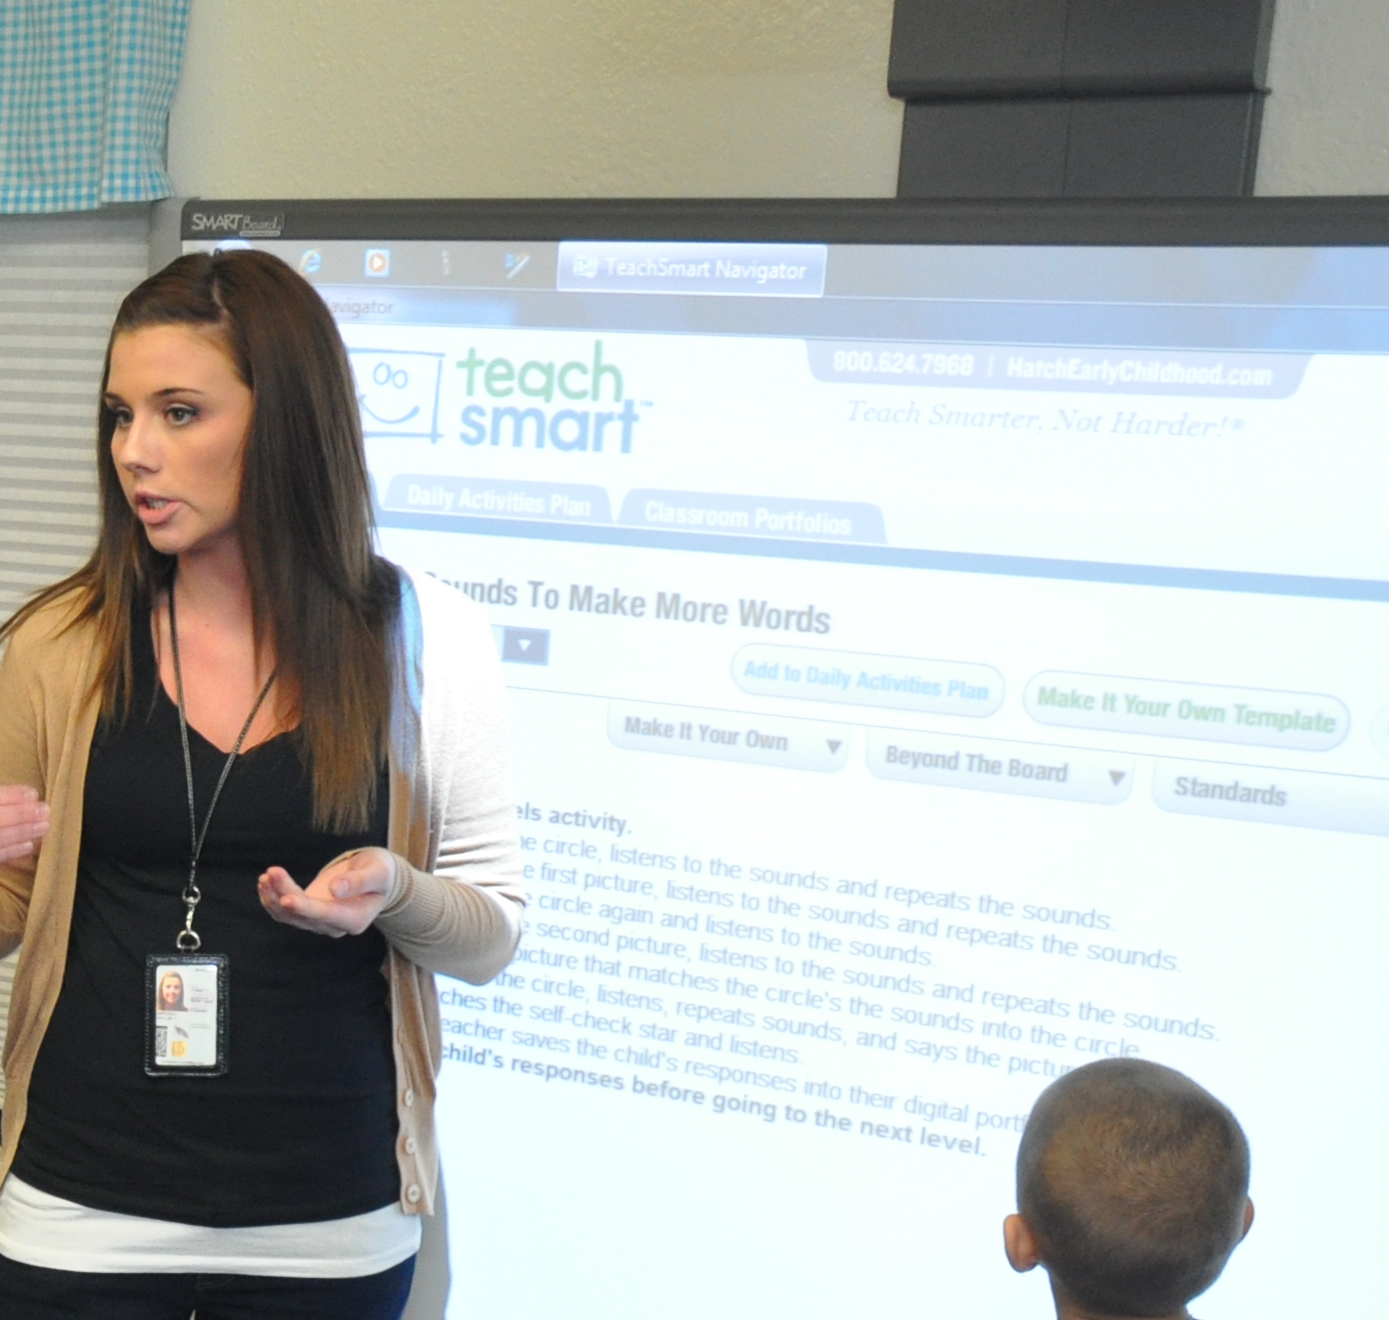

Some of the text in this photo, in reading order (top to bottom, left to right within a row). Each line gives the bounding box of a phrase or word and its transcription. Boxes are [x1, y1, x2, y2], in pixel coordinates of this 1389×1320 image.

[191, 213, 242, 231] SMART
[604, 252, 806, 284] TeachSmart Navigator
[328, 299, 395, 317] avigator
[456, 339, 623, 403] teach
[833, 351, 1273, 386] 800.624.7968 HatchEarlyChildhood.com
[460, 399, 639, 454] smart
[848, 400, 921, 425] Teach
[928, 405, 1043, 432] Smarter,
[1052, 409, 1104, 433] Not
[408, 485, 591, 514] Daily Activities Plan
[645, 501, 852, 536] Classroom Portfolios
[527, 581, 560, 611] To
[568, 585, 647, 618] Make
[655, 592, 729, 625] More
[739, 600, 831, 635] Words
[744, 661, 990, 702] Add to Daily Activities Plan
[624, 717, 789, 752] Make It Your Own
[1037, 687, 1337, 735] Make It Your Own Template
[885, 746, 1070, 784] Beyond The Board
[1173, 777, 1288, 808] Standards
[548, 810, 632, 838] activity.
[543, 840, 602, 864] circle,
[610, 844, 677, 871] listens
[683, 855, 703, 875] to
[709, 858, 742, 880] the
[750, 868, 829, 892] sounds
[836, 879, 878, 899] and
[884, 886, 971, 912] repeats
[978, 895, 1015, 918] the
[1022, 905, 1115, 931] sounds.
[538, 895, 593, 916] circle
[598, 904, 654, 926] again
[660, 913, 699, 932] and
[705, 916, 774, 943] listens
[781, 928, 801, 947] to
[808, 931, 842, 953] the
[849, 941, 932, 967] sounds.
[540, 862, 578, 886] first
[583, 873, 658, 899] picture,
[666, 881, 734, 908] listens
[741, 893, 761, 912] to
[767, 896, 801, 918] the
[808, 906, 890, 930] sounds
[897, 918, 939, 938] and
[946, 926, 1034, 951] repeats
[1042, 934, 1079, 958] the
[1087, 945, 1181, 972] sounds.
[536, 923, 610, 947] second
[616, 935, 691, 962] picture,
[699, 944, 768, 972] listens
[775, 956, 795, 976] to
[802, 960, 836, 982] the
[843, 970, 925, 995] sounds
[932, 984, 975, 1004] and
[981, 991, 1071, 1018] repeats
[1078, 1002, 1116, 1026] the
[1123, 1013, 1219, 1041] sounds.
[584, 955, 622, 978] that
[628, 966, 719, 993] matches
[726, 978, 759, 1000] the
[765, 988, 842, 1013] circle's
[849, 997, 884, 1019] the
[891, 1008, 974, 1034] sounds
[981, 1021, 1023, 1042] into
[1030, 1026, 1067, 1049] the
[492, 996, 523, 1018] the
[529, 1006, 632, 1035] self-check
[639, 1024, 678, 1043] star
[684, 1032, 723, 1051] and
[729, 1036, 799, 1064] listens.
[531, 978, 589, 1004] circle,
[597, 985, 667, 1016] listens,
[676, 1003, 755, 1028] repeats
[763, 1017, 847, 1046] sounds,
[856, 1032, 898, 1052] and
[905, 1040, 958, 1063] says
[965, 1046, 1001, 1069] the
[512, 1031, 571, 1054] saves
[576, 1039, 608, 1061] the
[613, 1047, 678, 1072] child's
[684, 1061, 797, 1093] responses
[804, 1081, 842, 1101] into
[849, 1086, 897, 1111] their
[903, 1096, 970, 1123] digital
[511, 1059, 625, 1090] responses
[632, 1076, 706, 1105] before
[712, 1095, 777, 1123] going
[784, 1105, 808, 1124] to
[814, 1110, 853, 1132] the
[860, 1122, 913, 1144] next
[920, 1126, 987, 1156] level.
